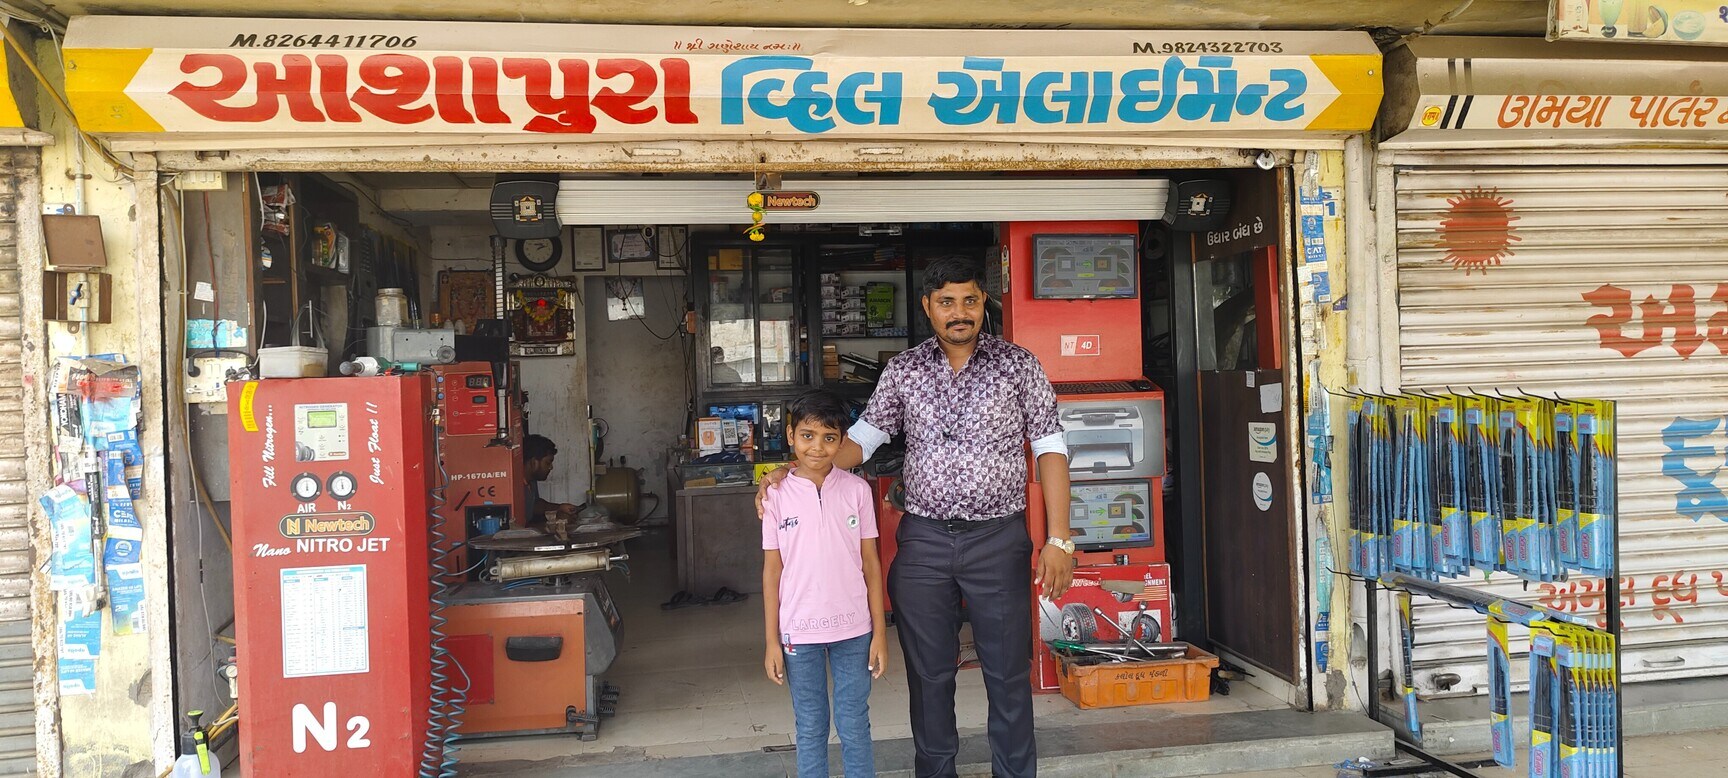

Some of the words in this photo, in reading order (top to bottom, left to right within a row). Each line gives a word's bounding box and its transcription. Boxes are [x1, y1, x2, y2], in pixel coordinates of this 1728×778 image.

[229, 33, 419, 48] M.8264411706
[1133, 41, 1283, 54] M.9824322703
[167, 52, 697, 134] આશાપુરા
[1498, 80, 1611, 129] ઉમિયા
[1207, 231, 1230, 246] ઉધાર
[1233, 223, 1251, 240] બંધ
[1253, 216, 1263, 234] છે
[1064, 341, 1075, 350] NT
[1081, 341, 1093, 350] 4D
[366, 418, 382, 454] Float
[262, 465, 277, 488] Fill
[369, 457, 384, 485] Just
[451, 471, 507, 481] HP-1670A/EN
[297, 503, 316, 513] AIR
[305, 516, 369, 533] Newtech
[252, 543, 291, 557] Nano
[296, 538, 352, 553] NITRO
[357, 537, 390, 552] JET
[791, 612, 855, 631] LARGELY
